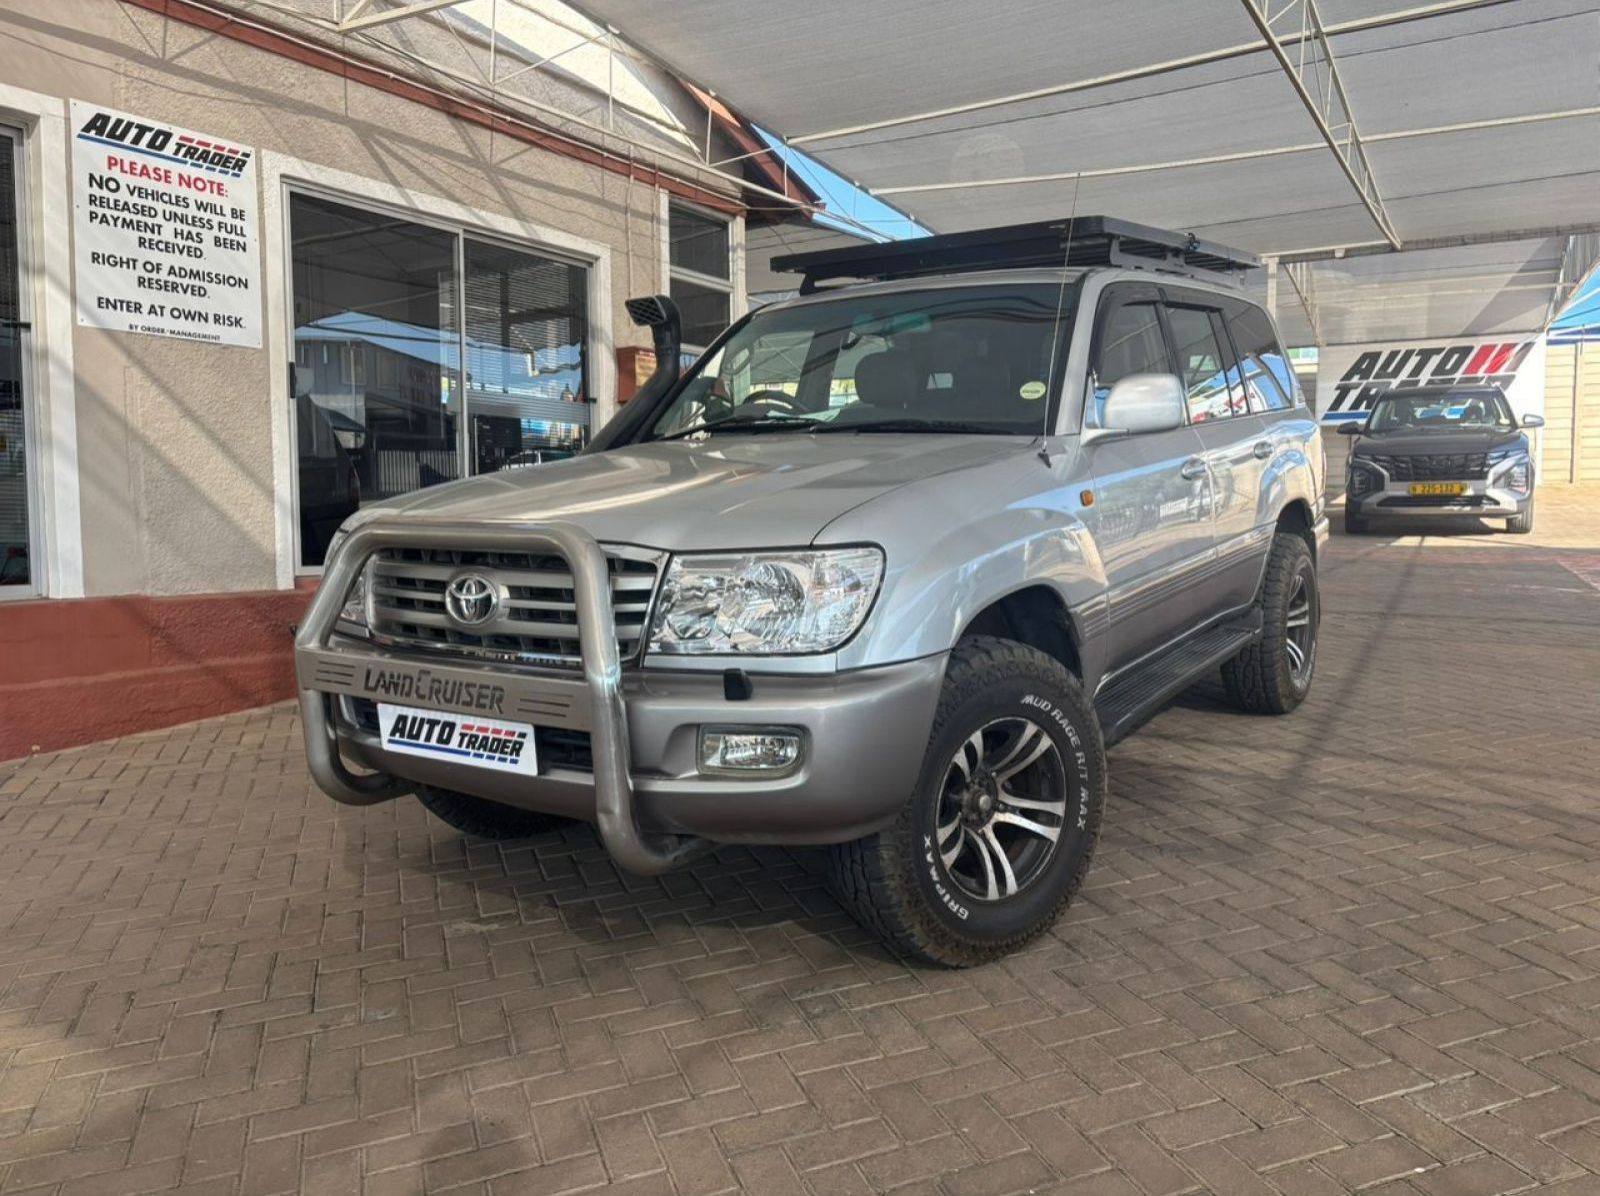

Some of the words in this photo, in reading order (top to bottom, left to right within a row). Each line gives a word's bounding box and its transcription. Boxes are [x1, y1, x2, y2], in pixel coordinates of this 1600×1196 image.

[80, 112, 174, 151] AUTO
[172, 142, 248, 173] TRADER
[88, 172, 121, 194] NO
[126, 184, 190, 209] VEHICLES
[194, 200, 226, 218] WILL
[230, 208, 246, 222] BE
[106, 155, 172, 184] PLEASE
[178, 173, 229, 197] NOTE:
[88, 194, 158, 219] RELEASED
[162, 209, 214, 231] UNLESS
[218, 222, 247, 238] FULL
[89, 211, 163, 236] PAYMENT
[174, 229, 204, 245] HAS
[213, 236, 247, 253] BEEN
[138, 237, 207, 260] RECEIVED.
[91, 252, 139, 271] RIGHT
[142, 261, 163, 275] OF
[167, 266, 249, 289] ADMISSION
[137, 276, 211, 299] RESERVED.
[96, 297, 143, 315] ENTER
[147, 304, 166, 318] AT
[170, 307, 209, 324] OWN
[213, 314, 247, 329] RISK.
[128, 323, 140, 331] BY
[1340, 345, 1475, 381] AUTO
[390, 714, 457, 746] AUTO
[458, 733, 525, 762] TRADER
[1020, 695, 1052, 712] MUD
[1050, 708, 1081, 748] RAGE
[1077, 786, 1089, 831] MAX
